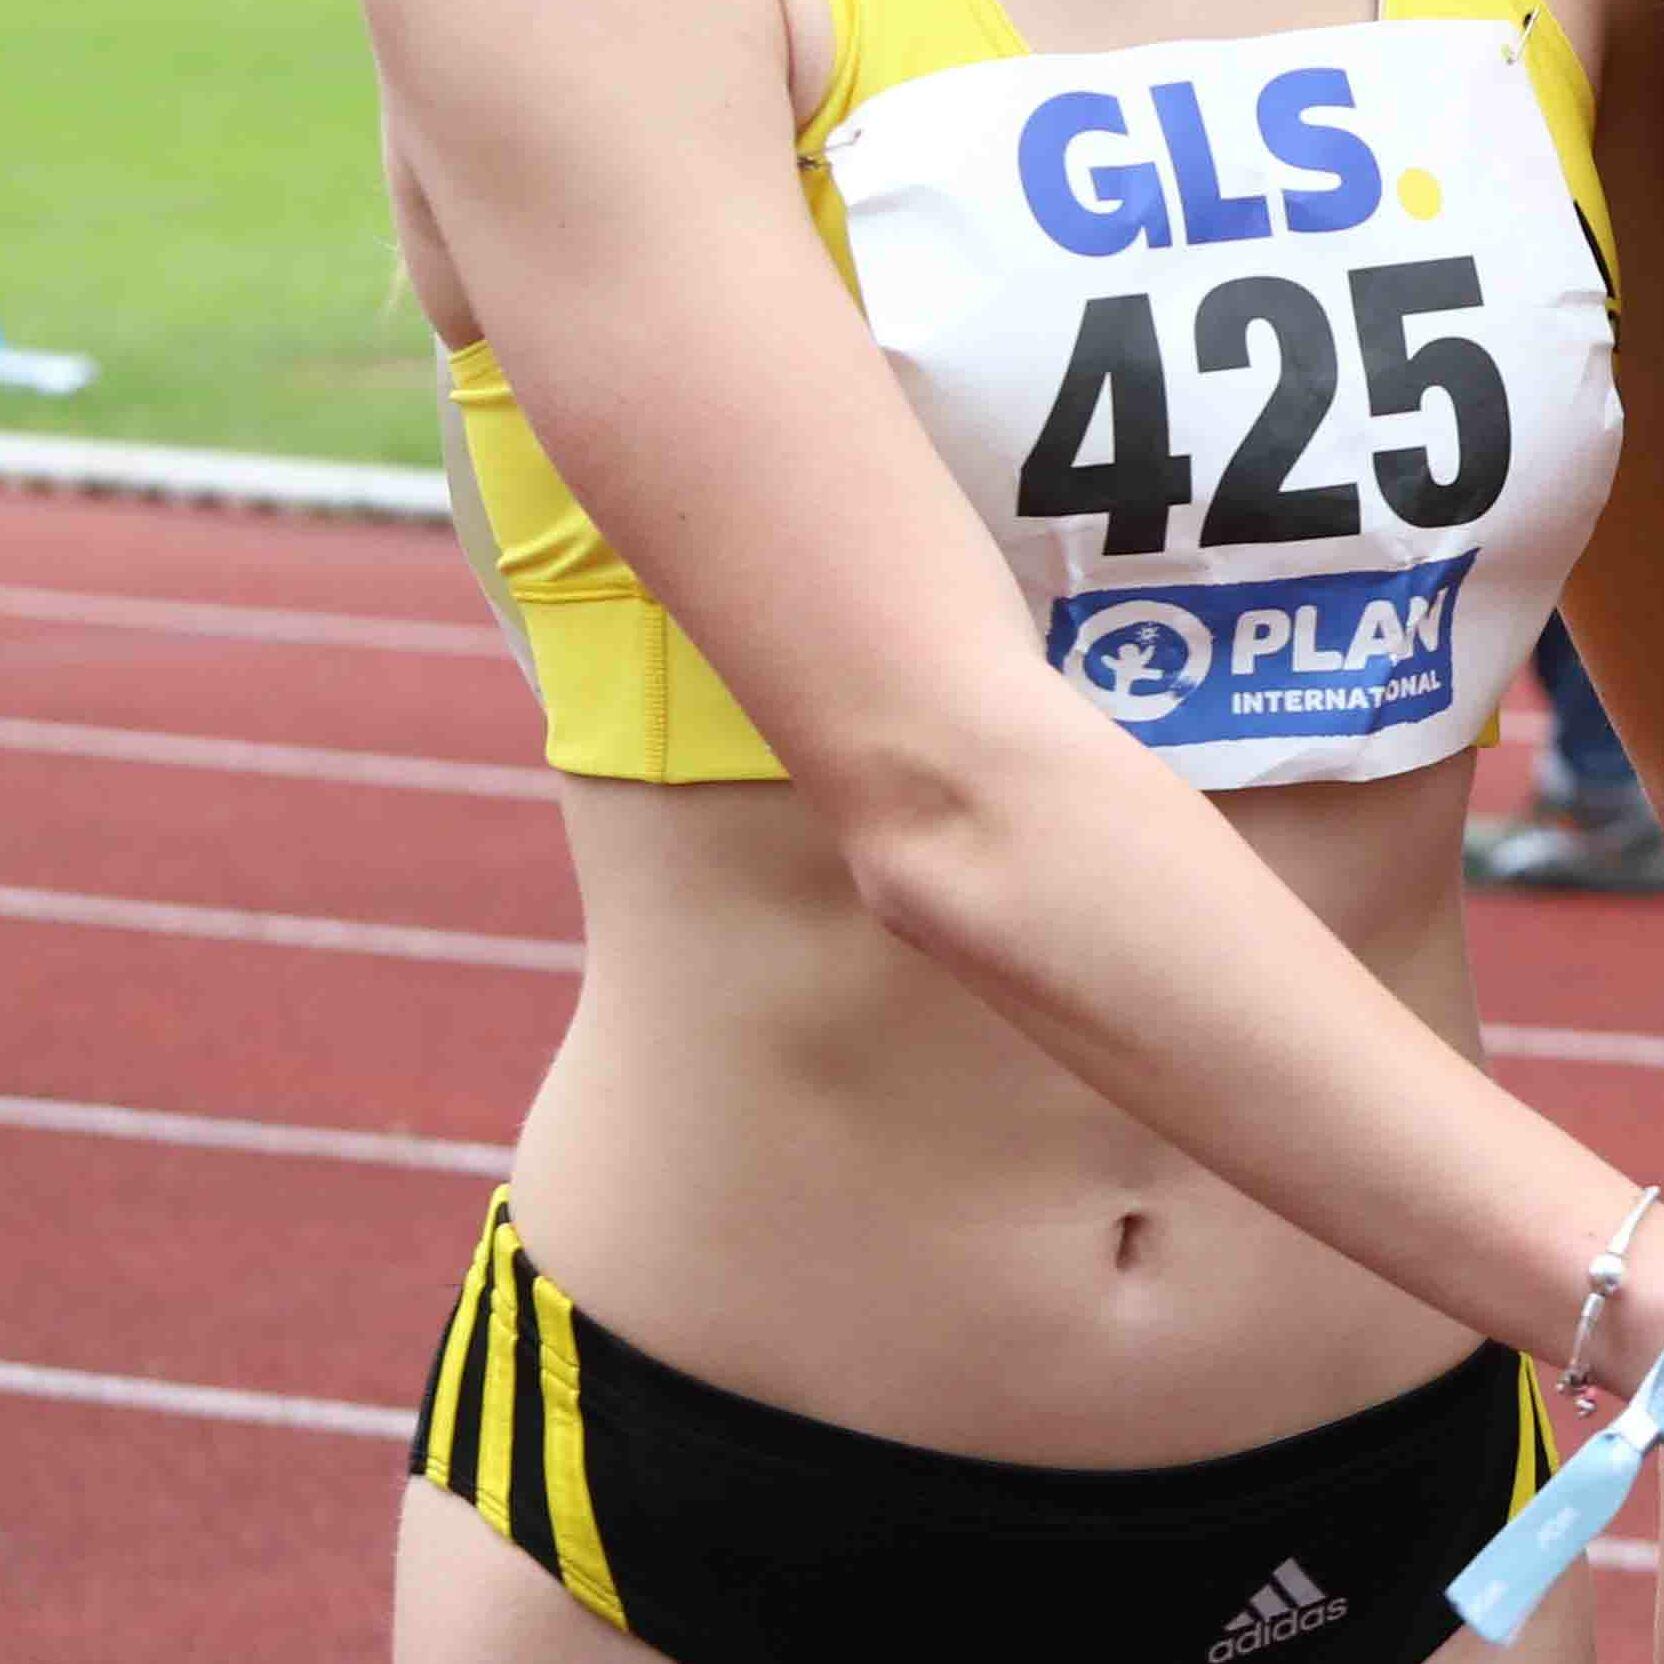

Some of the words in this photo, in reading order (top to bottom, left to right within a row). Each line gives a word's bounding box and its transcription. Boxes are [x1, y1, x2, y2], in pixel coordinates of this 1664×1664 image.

[1017, 255, 1513, 557] 425
[1230, 586, 1448, 677] PLAN
[1232, 670, 1442, 715] INTERNATONAL
[1207, 1597, 1348, 1664] adidas
